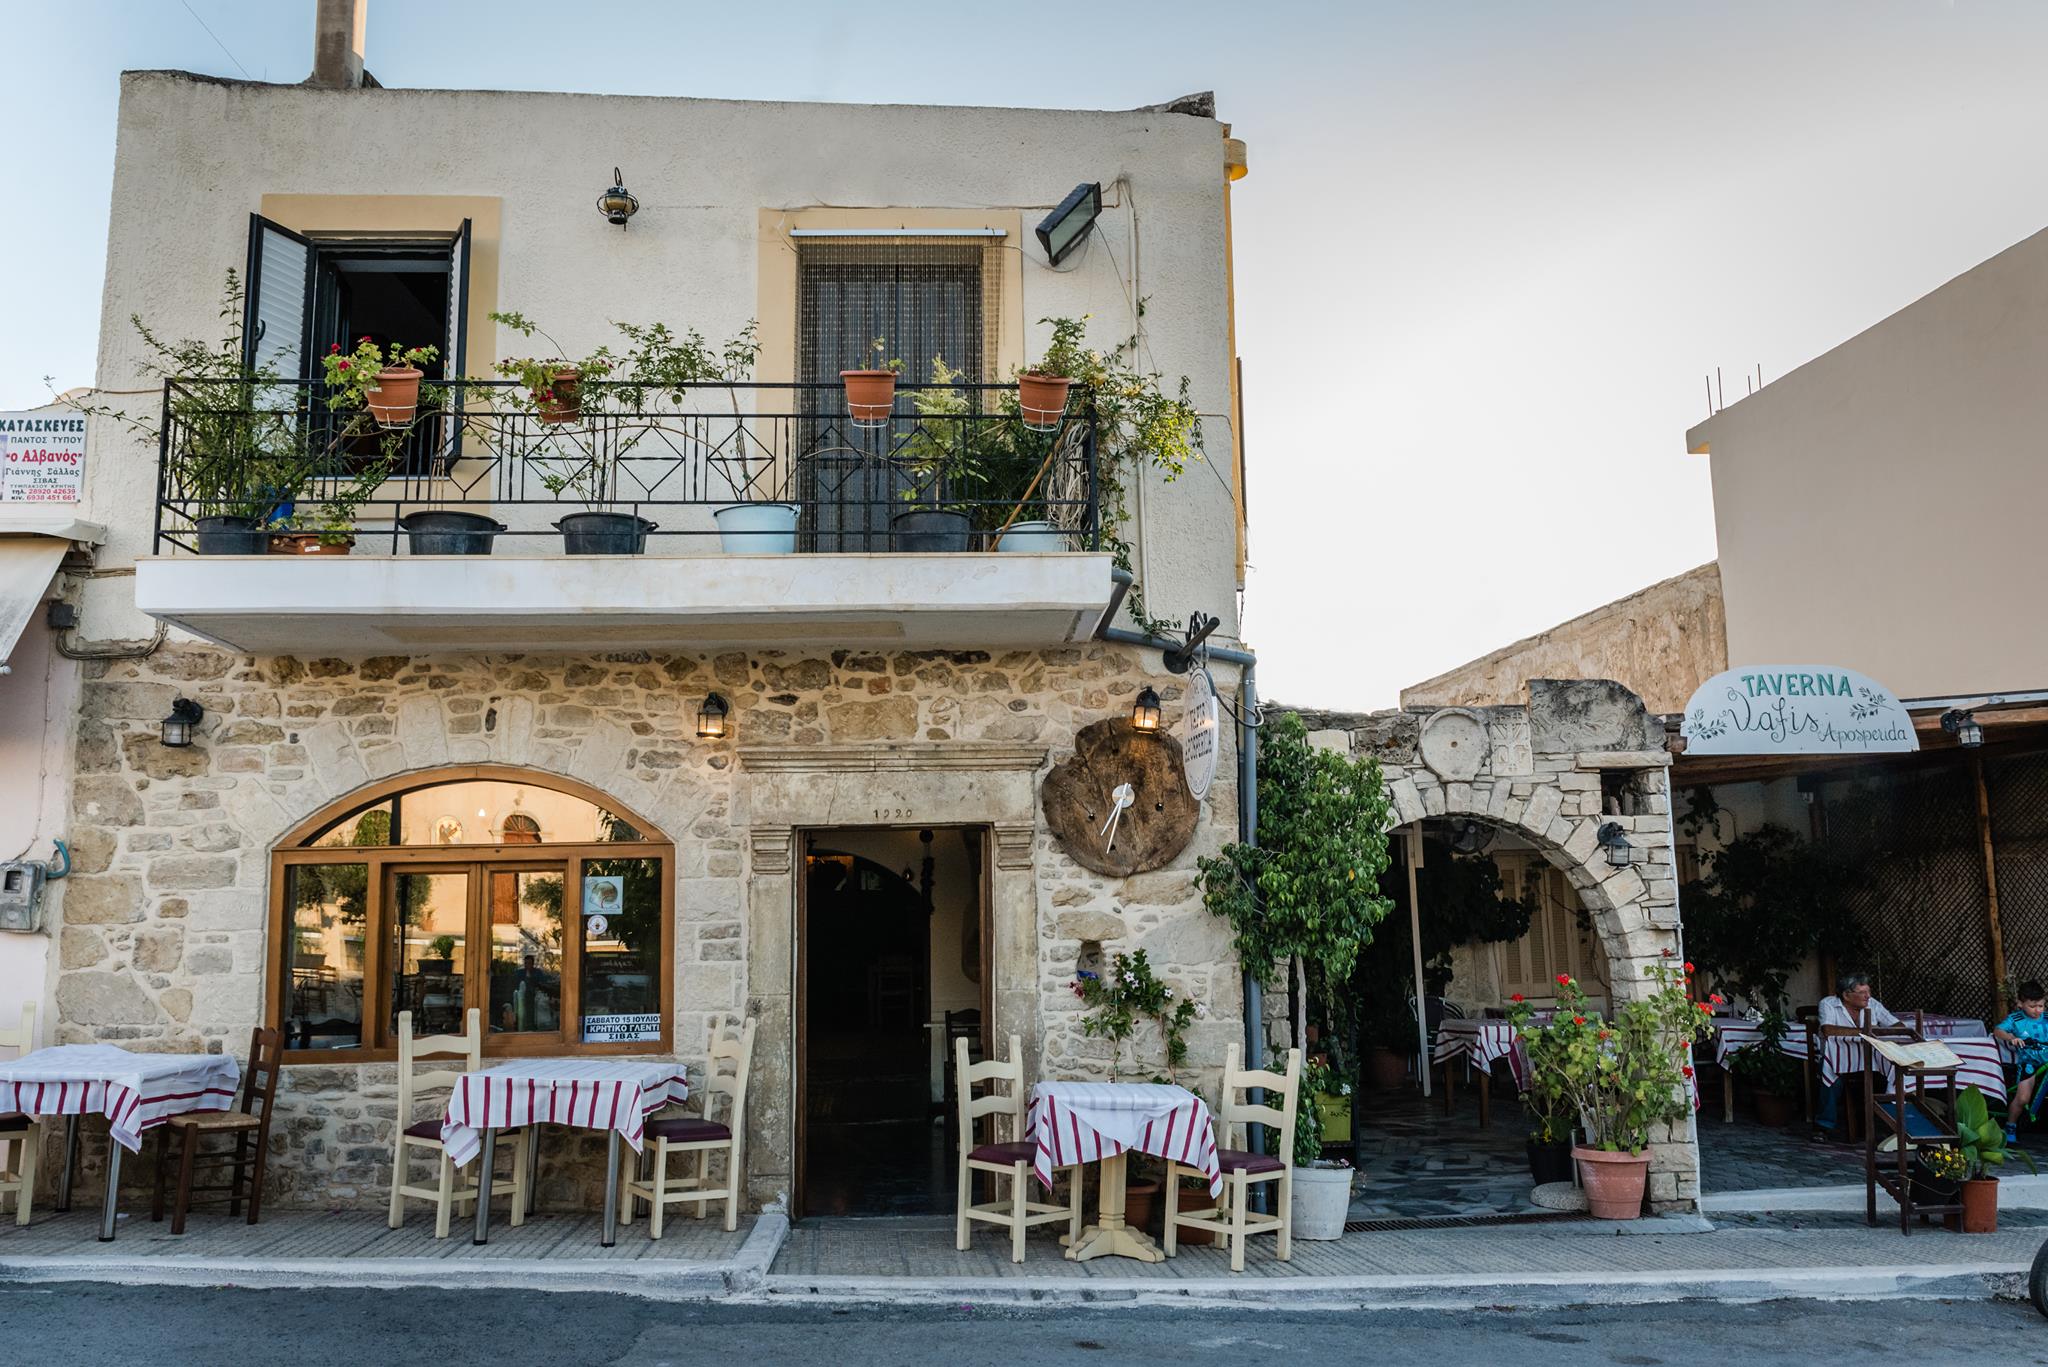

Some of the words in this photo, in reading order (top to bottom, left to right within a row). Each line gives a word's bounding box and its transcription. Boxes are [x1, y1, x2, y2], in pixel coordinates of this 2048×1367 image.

[0, 419, 84, 432] ΚΑΤΑΣΚΕΥΕΣ
[11, 436, 48, 444] ΠΑΝΤΟΣ
[52, 436, 83, 444] ΤΥΠΟΥ
[5, 467, 42, 477] Γιάννης
[47, 467, 80, 477] Σάλλας
[1741, 673, 1853, 698] TAVERNA
[1719, 686, 1819, 743] Vafis
[586, 1016, 620, 1024] ΣΑΒΒΑΤΟ
[632, 1015, 661, 1023] ΙΟΥΛΙΟ
[589, 1025, 627, 1033] ΚΡΗΤΙΚΟ
[608, 1032, 640, 1040] ΣΙΒΑΣ
